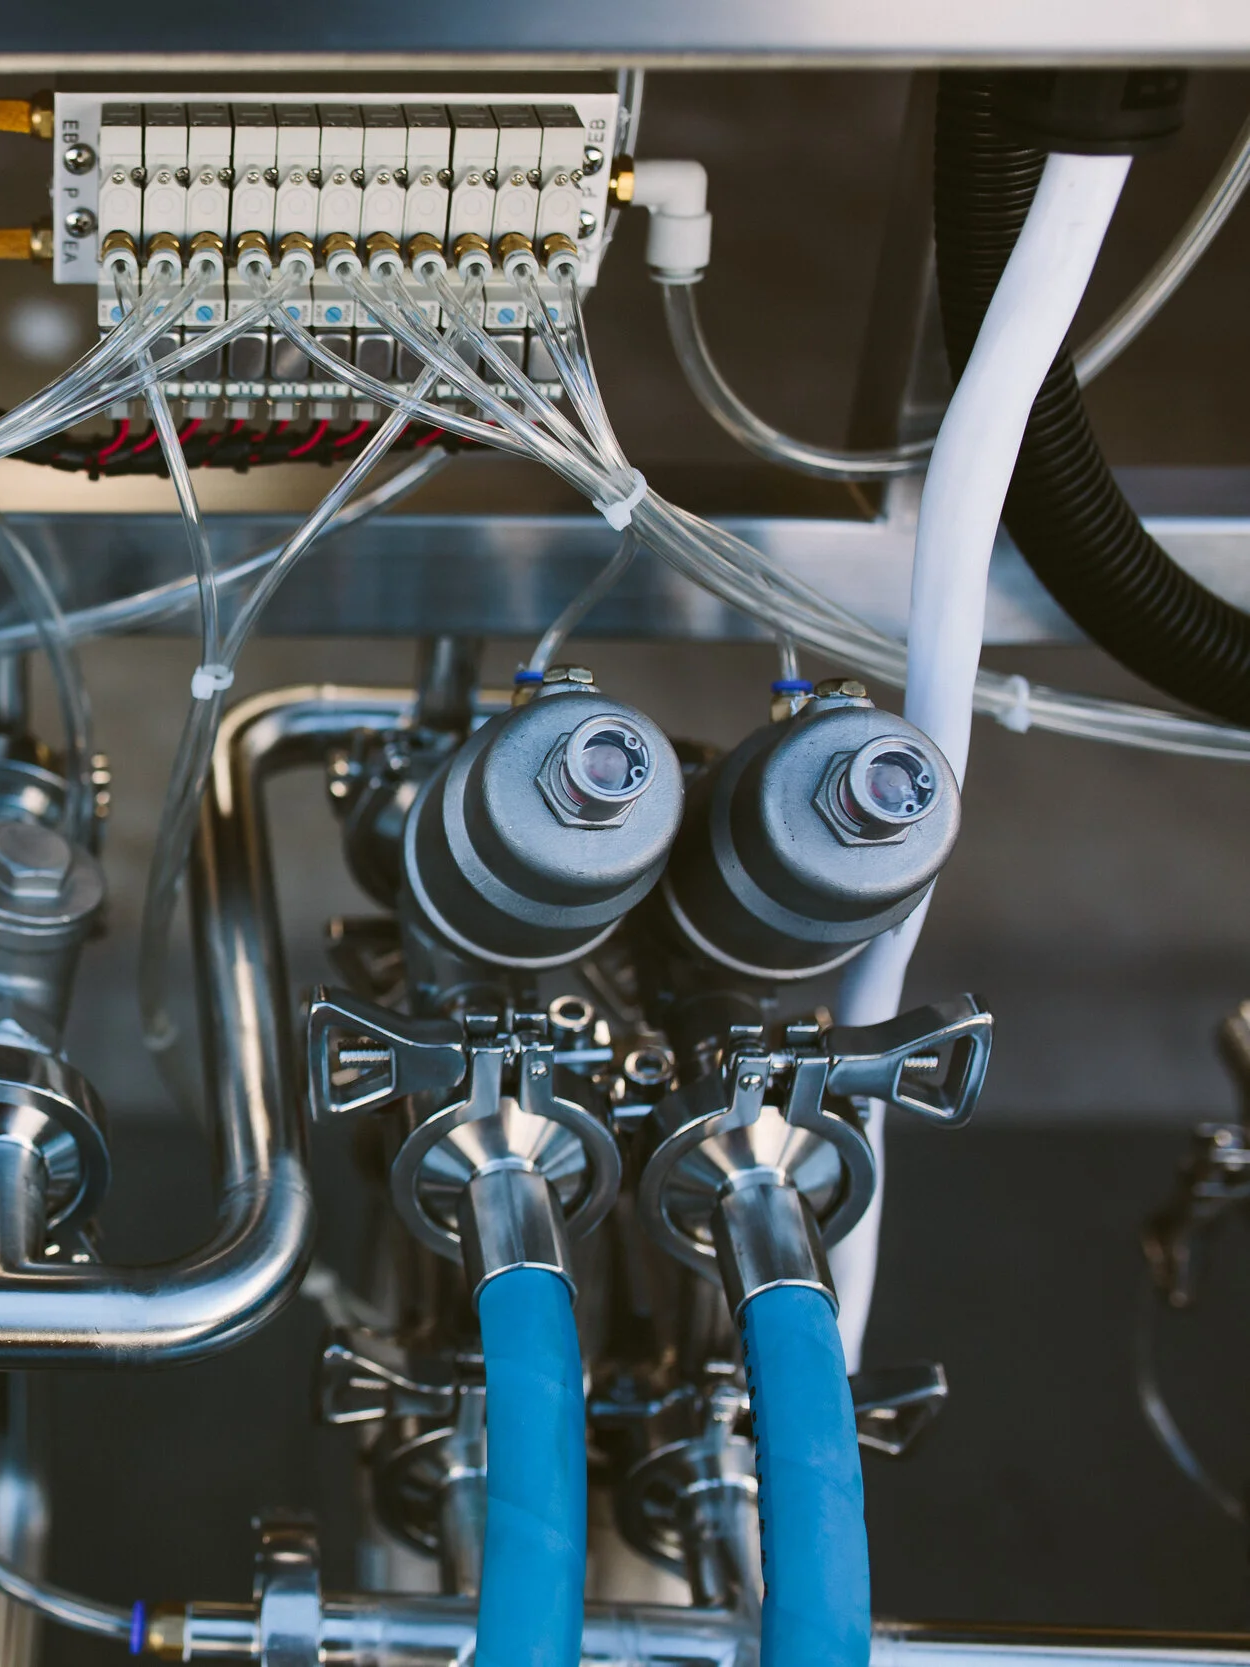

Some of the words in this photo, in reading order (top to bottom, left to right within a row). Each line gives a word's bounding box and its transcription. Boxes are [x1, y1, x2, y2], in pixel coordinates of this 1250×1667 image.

[62, 120, 79, 144] EB
[588, 119, 606, 143] EB
[62, 187, 79, 199] P
[62, 241, 79, 264] EA
